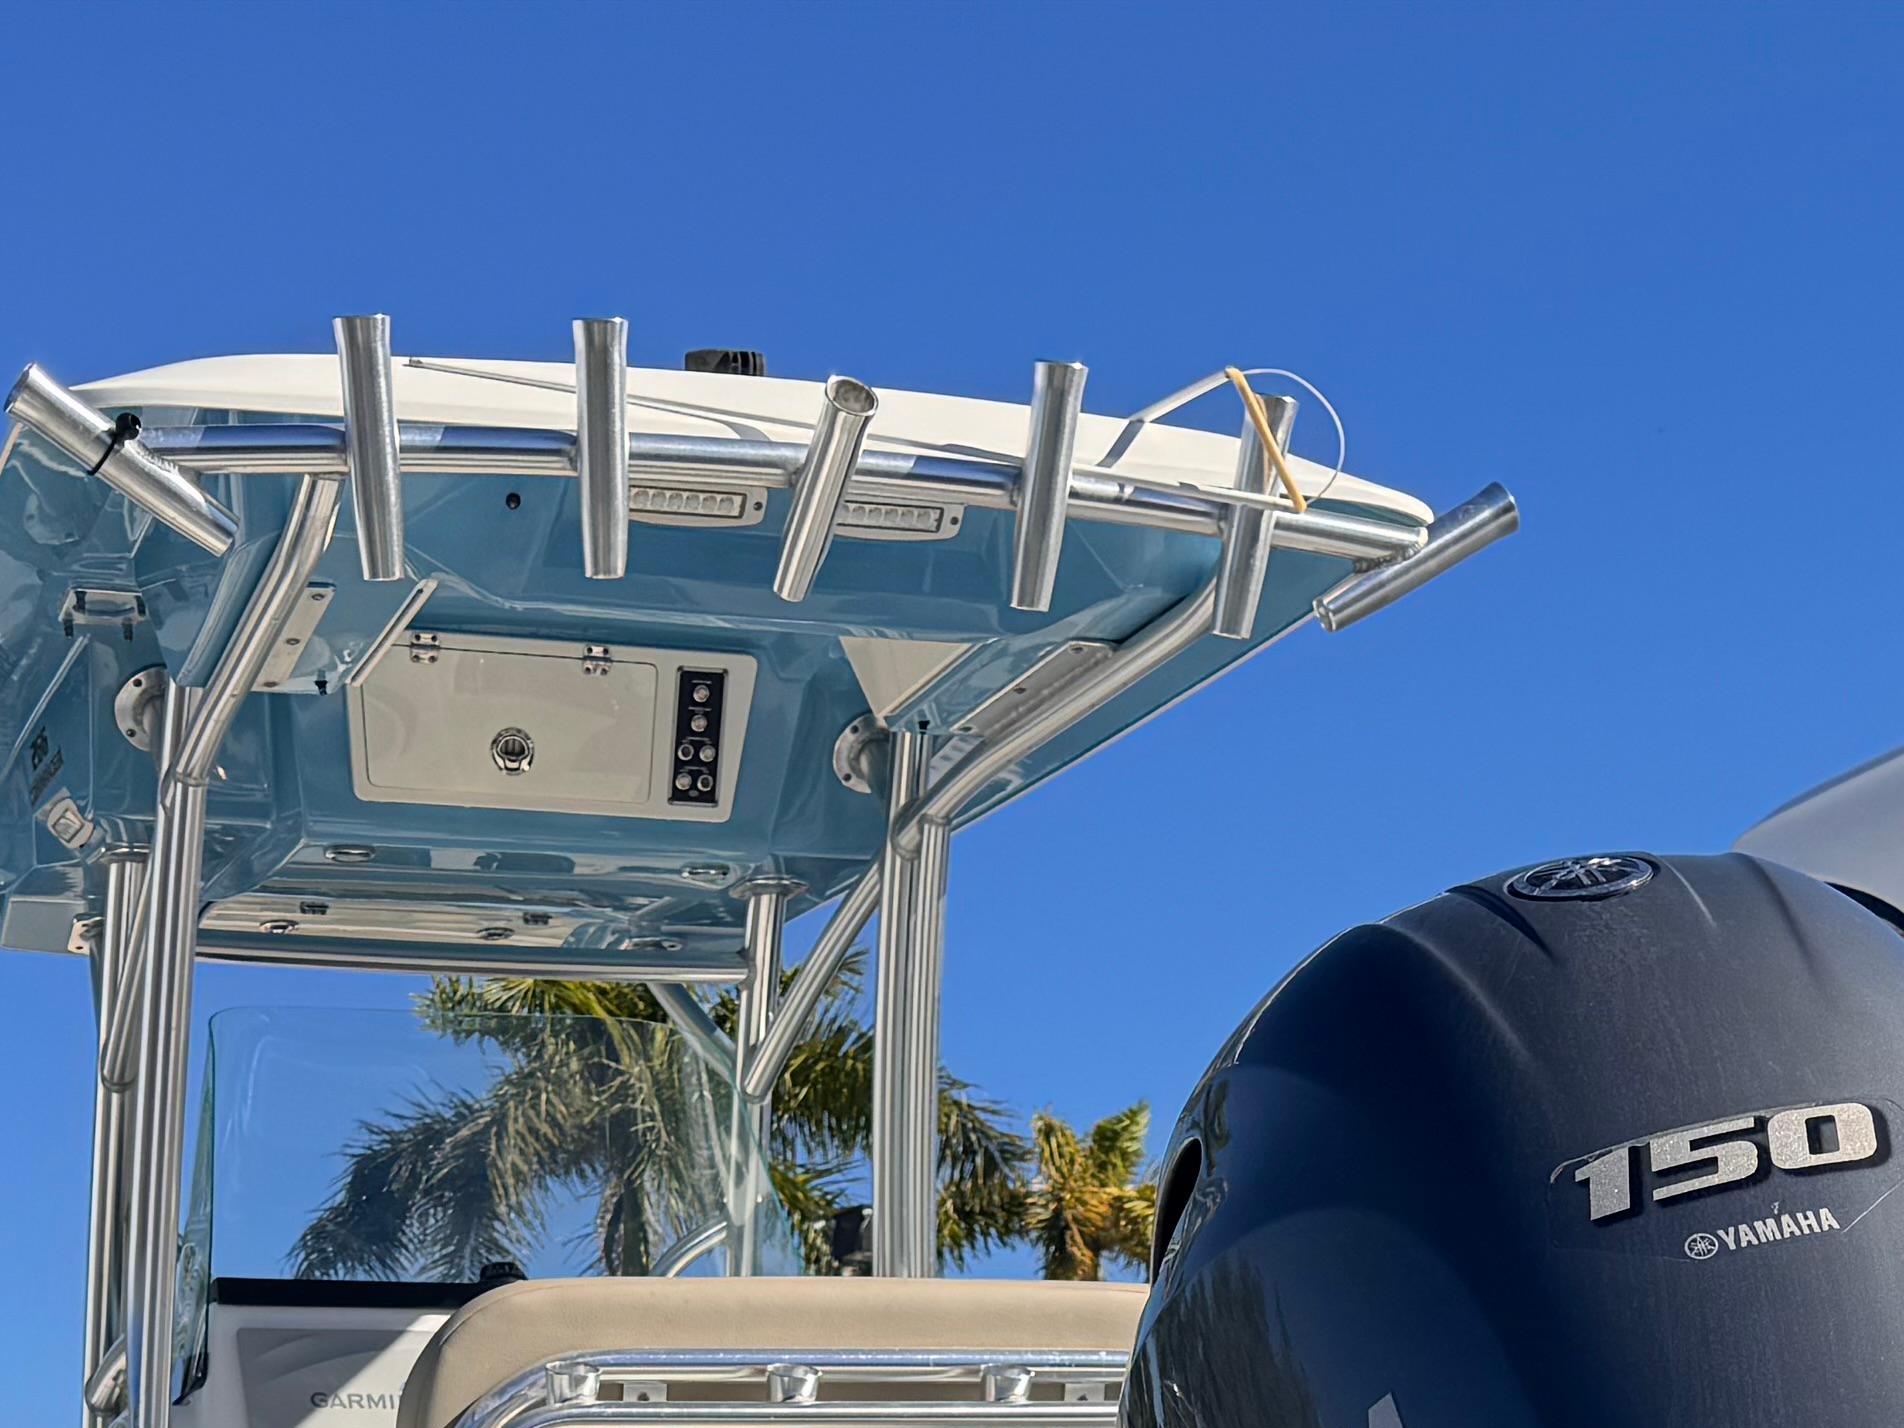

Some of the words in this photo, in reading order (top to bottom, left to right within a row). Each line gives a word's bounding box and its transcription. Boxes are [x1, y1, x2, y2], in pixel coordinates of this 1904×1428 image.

[1574, 1102, 1878, 1221] 150
[1717, 1206, 1841, 1251] YAMAHA
[309, 1391, 399, 1410] GARMI
